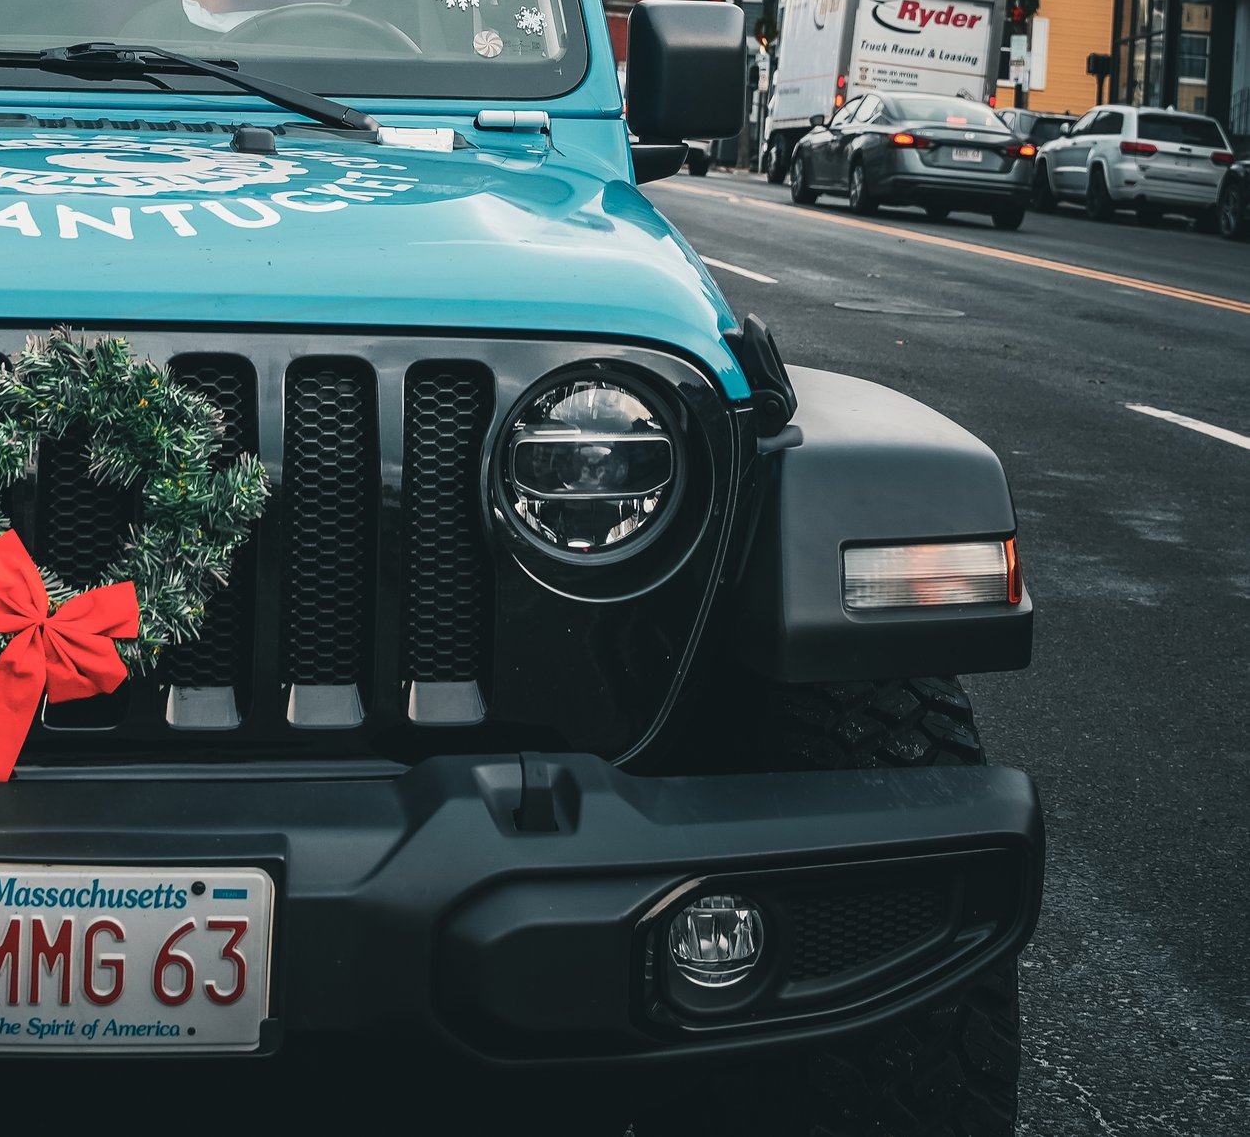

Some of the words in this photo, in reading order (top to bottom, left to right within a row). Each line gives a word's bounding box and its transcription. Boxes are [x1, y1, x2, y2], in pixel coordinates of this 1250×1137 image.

[897, 0, 982, 29] Ryder
[860, 40, 887, 52] Truck
[891, 44, 925, 57] Rental
[928, 49, 936, 59] &
[939, 50, 978, 65] Leasing
[153, 920, 248, 1005] 63
[27, 1017, 76, 1040] Spirit
[81, 1019, 99, 1040] of
[103, 1019, 181, 1037] America
